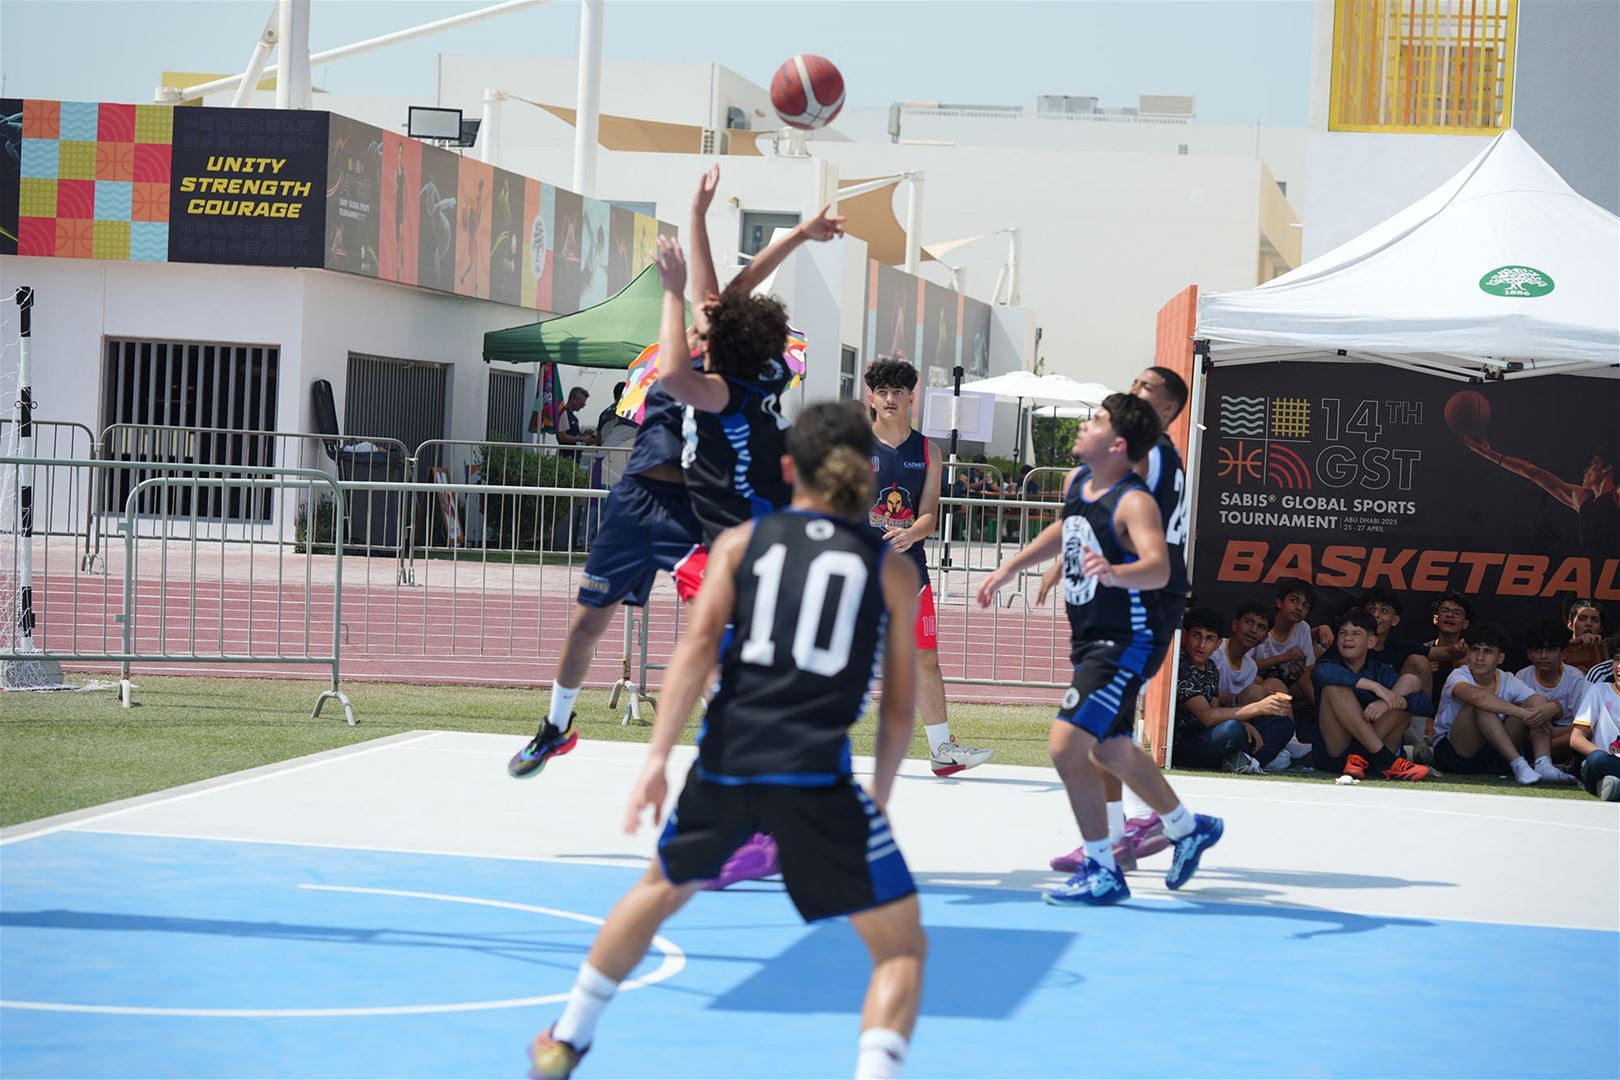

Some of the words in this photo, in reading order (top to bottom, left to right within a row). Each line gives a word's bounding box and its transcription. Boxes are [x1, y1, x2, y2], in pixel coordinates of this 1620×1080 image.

[207, 156, 286, 173] UNITY
[180, 177, 311, 197] STRENGTH
[187, 199, 302, 219] COURAGE
[1315, 445, 1421, 491] GST
[1281, 495, 1348, 511] GLOBAL
[1353, 499, 1416, 515] SPORTS
[1219, 510, 1338, 529] TOURNAMENT
[1344, 516, 1358, 524] ABU
[1359, 517, 1380, 525] DHABI
[1381, 518, 1398, 526] 2025
[740, 542, 868, 677] 10
